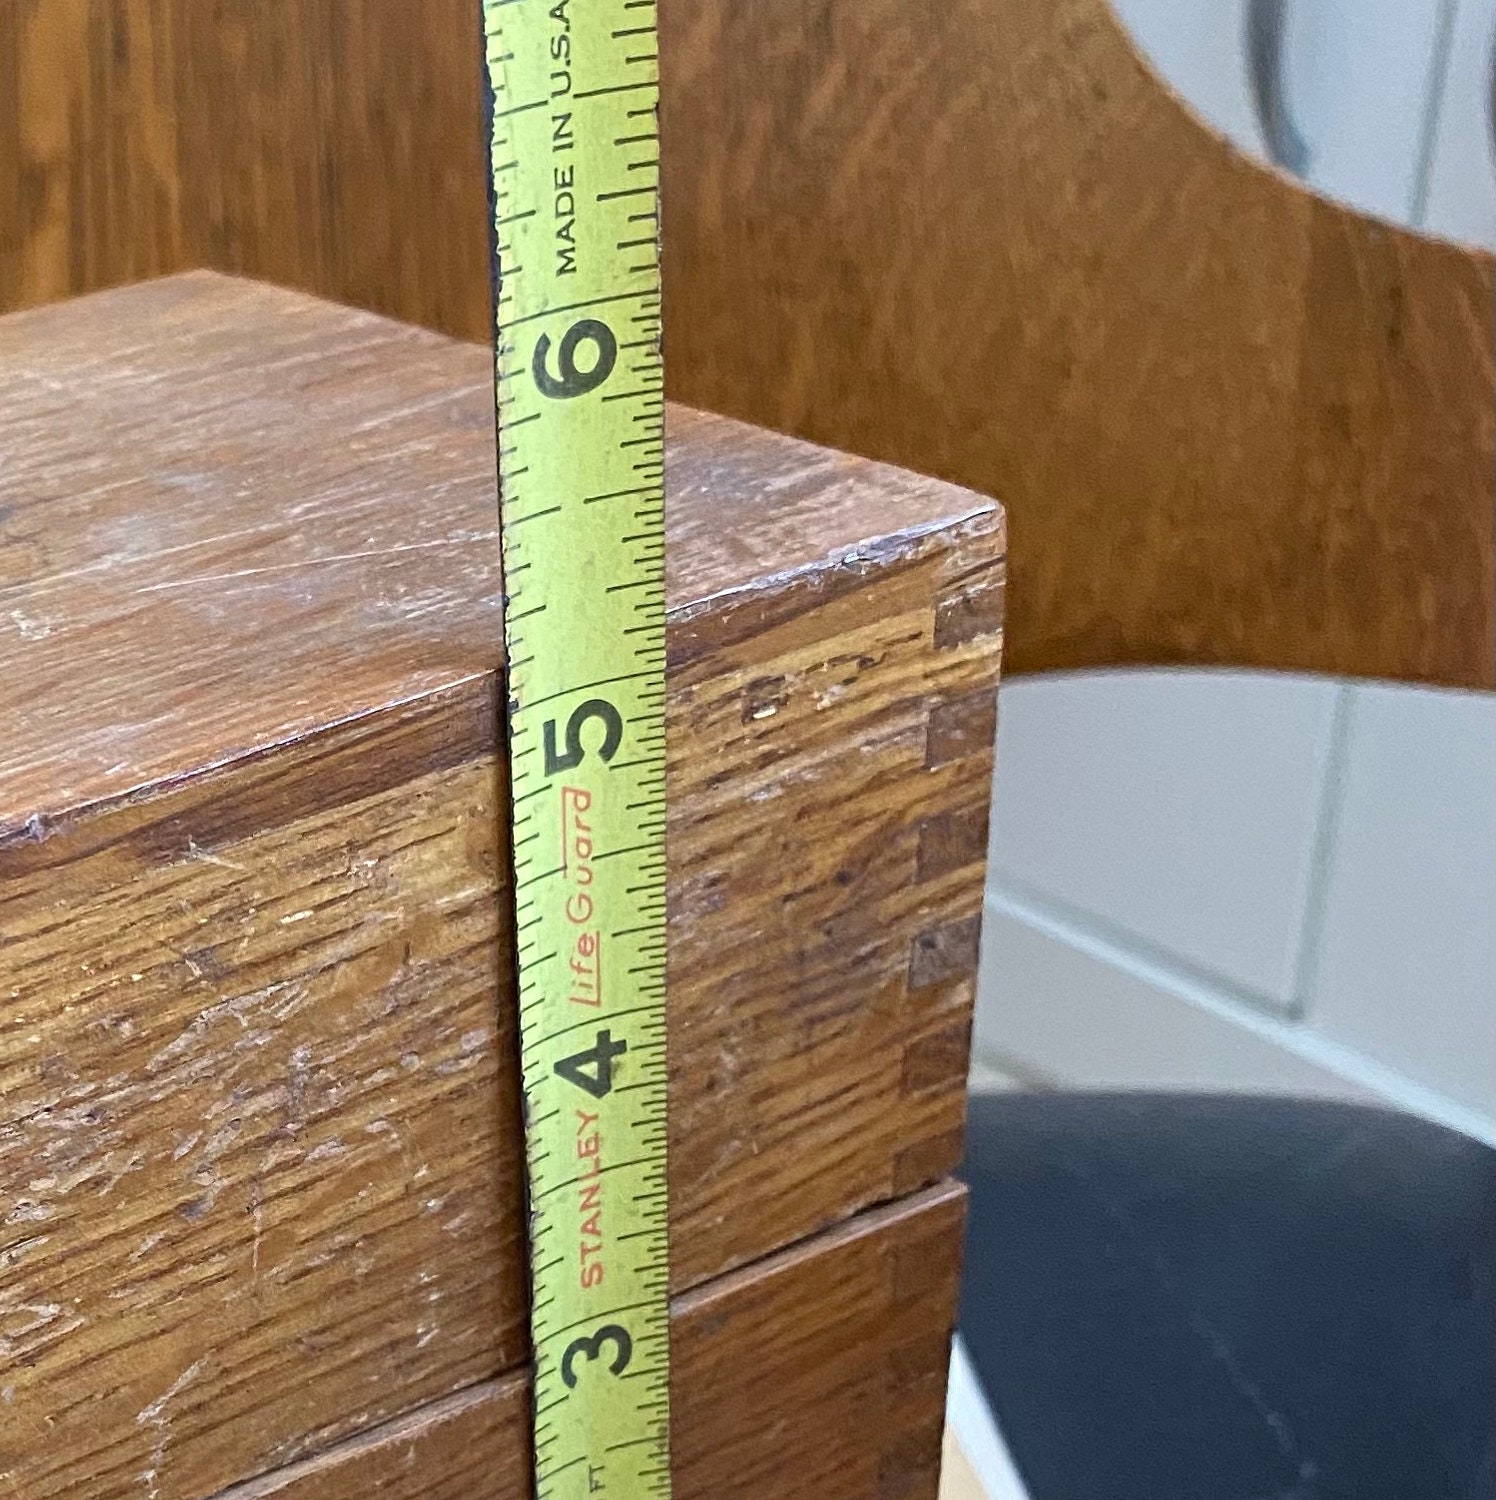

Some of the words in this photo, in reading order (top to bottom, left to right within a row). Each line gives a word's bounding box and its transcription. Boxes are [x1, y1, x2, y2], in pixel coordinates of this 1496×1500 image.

[552, 112, 575, 153] IN
[554, 164, 578, 278] MADE
[531, 318, 618, 400] 6
[542, 698, 623, 777] 5
[553, 1028, 628, 1100] 4
[575, 1108, 605, 1290] STANLEY
[561, 1323, 633, 1390] 3
